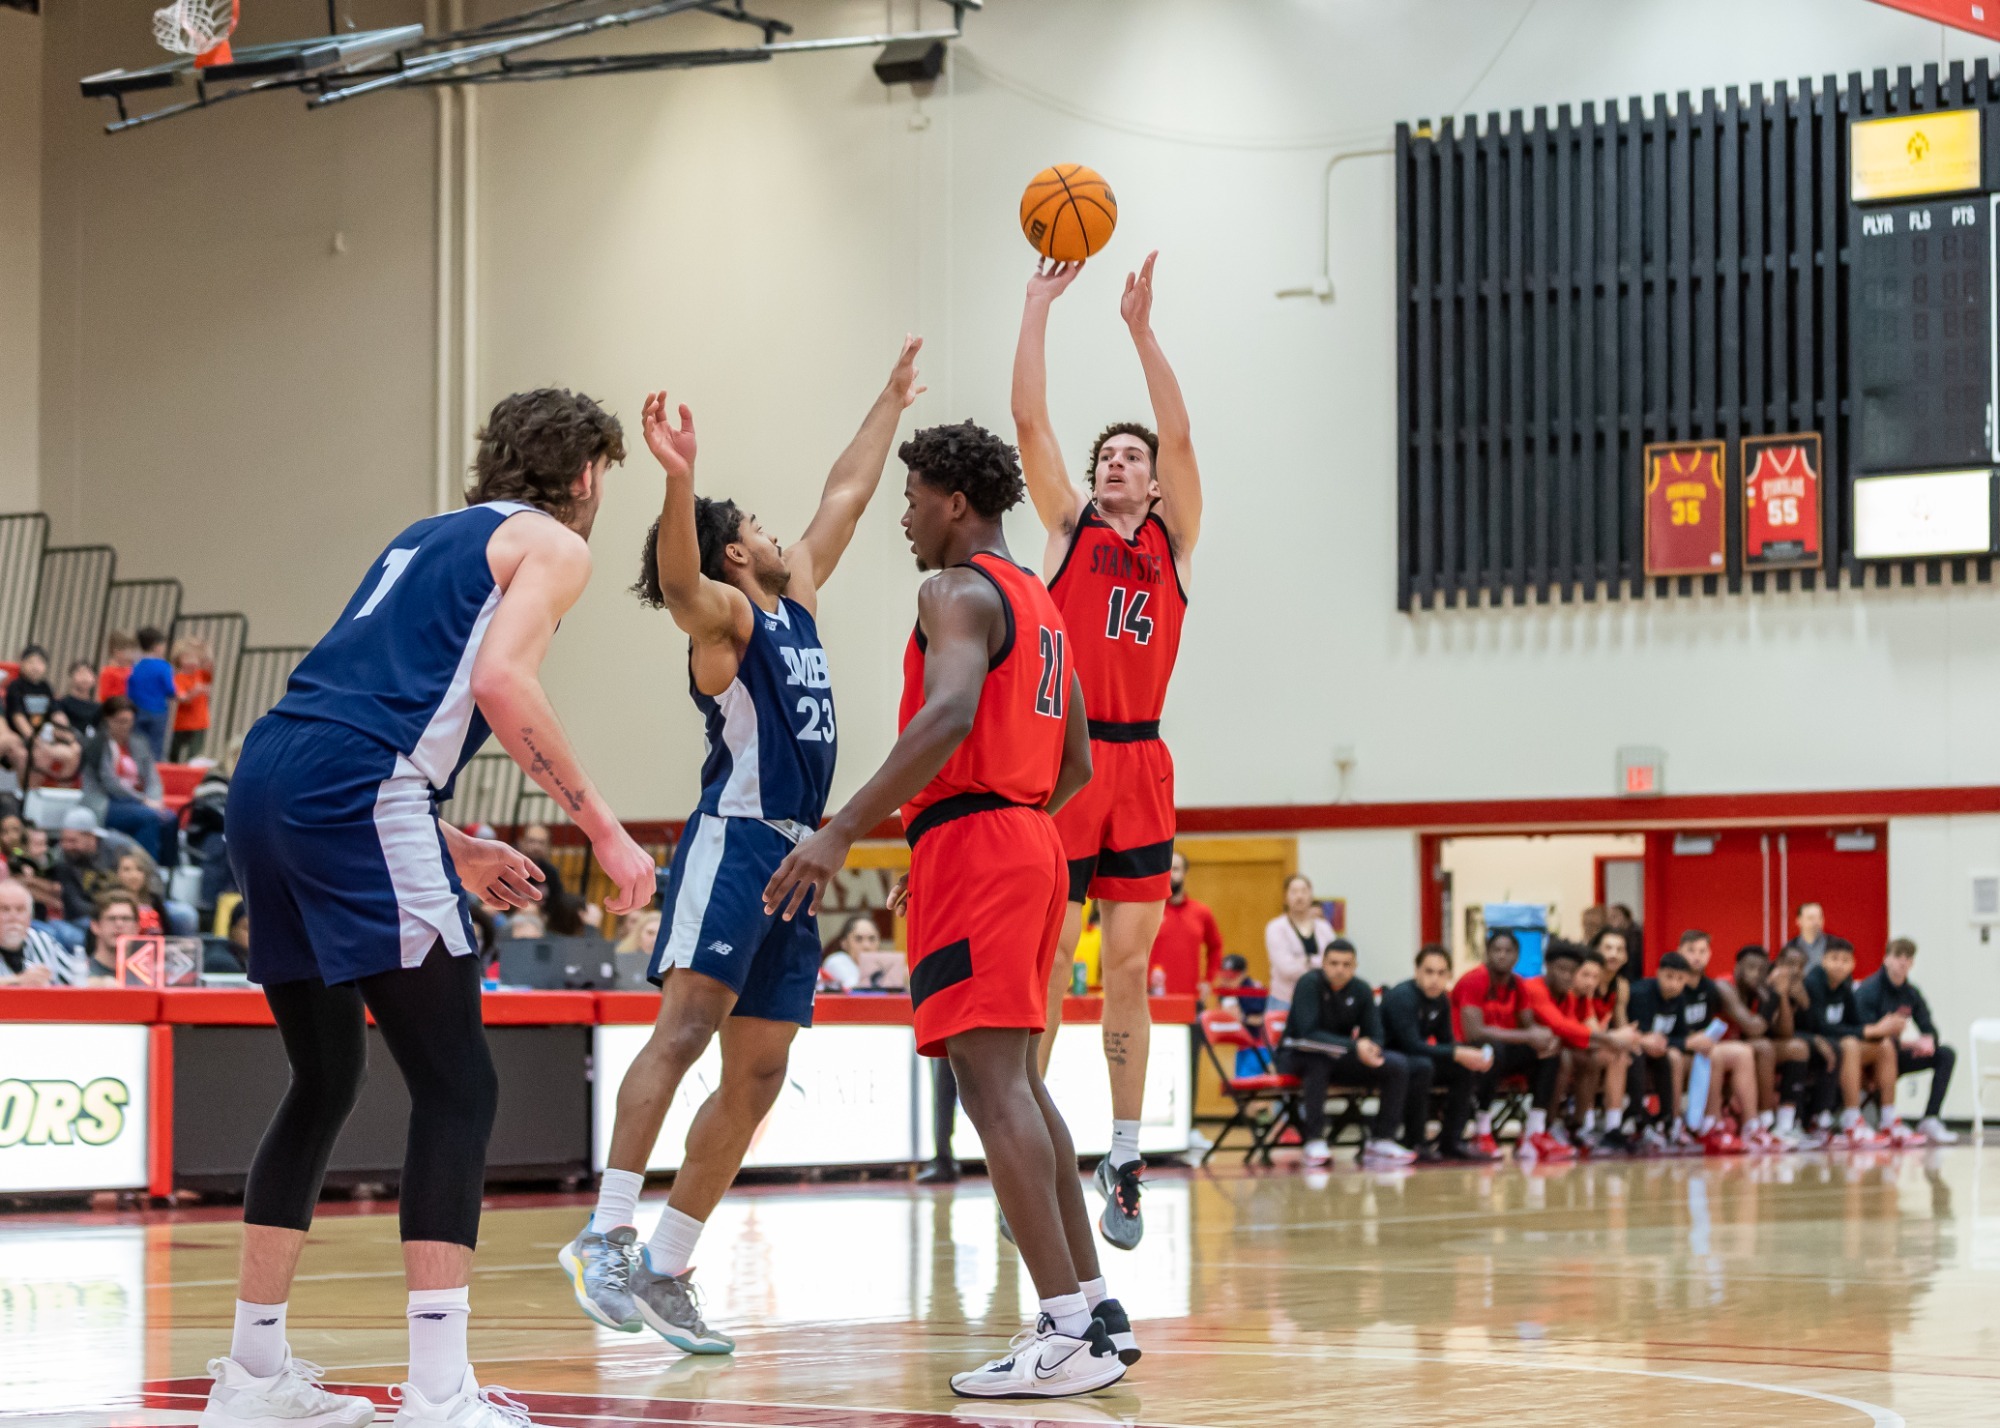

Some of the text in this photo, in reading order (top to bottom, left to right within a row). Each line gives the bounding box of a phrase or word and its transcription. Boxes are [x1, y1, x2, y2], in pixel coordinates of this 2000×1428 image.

[1862, 205, 1976, 236] PLYR FLS PTS
[1767, 498, 1799, 526] 55
[353, 545, 421, 621] 1
[1090, 545, 1132, 579] STAN
[1105, 586, 1154, 645] 14
[1034, 624, 1064, 719] 21
[796, 696, 836, 744] 23
[0, 1077, 130, 1148] ORS
